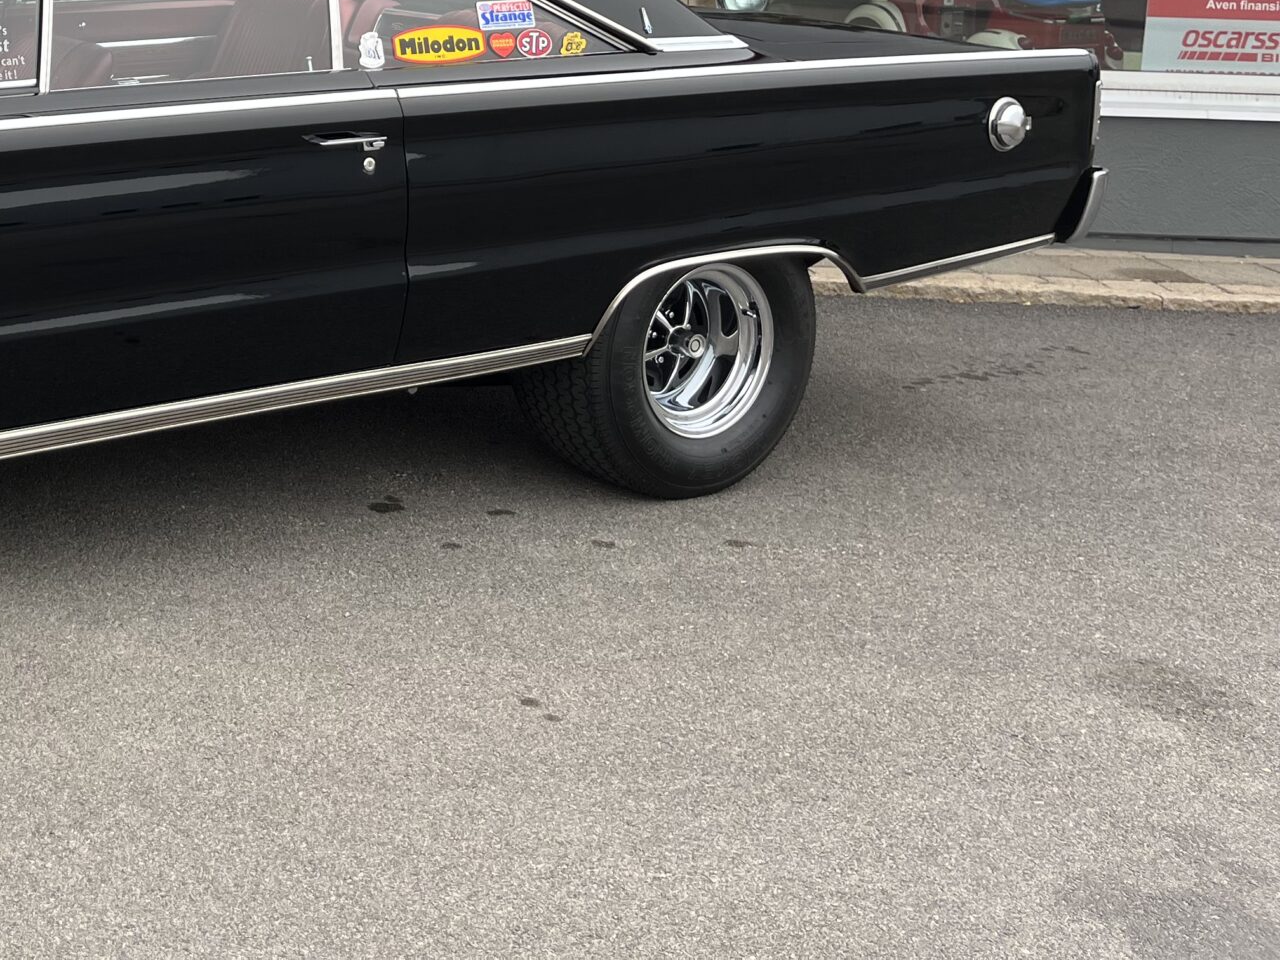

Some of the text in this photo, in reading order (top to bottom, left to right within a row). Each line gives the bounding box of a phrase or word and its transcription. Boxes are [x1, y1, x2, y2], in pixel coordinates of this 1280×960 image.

[480, 10, 533, 26] Strange
[399, 35, 481, 56] Milodon
[521, 31, 548, 54] STP
[1, 55, 26, 66] can't
